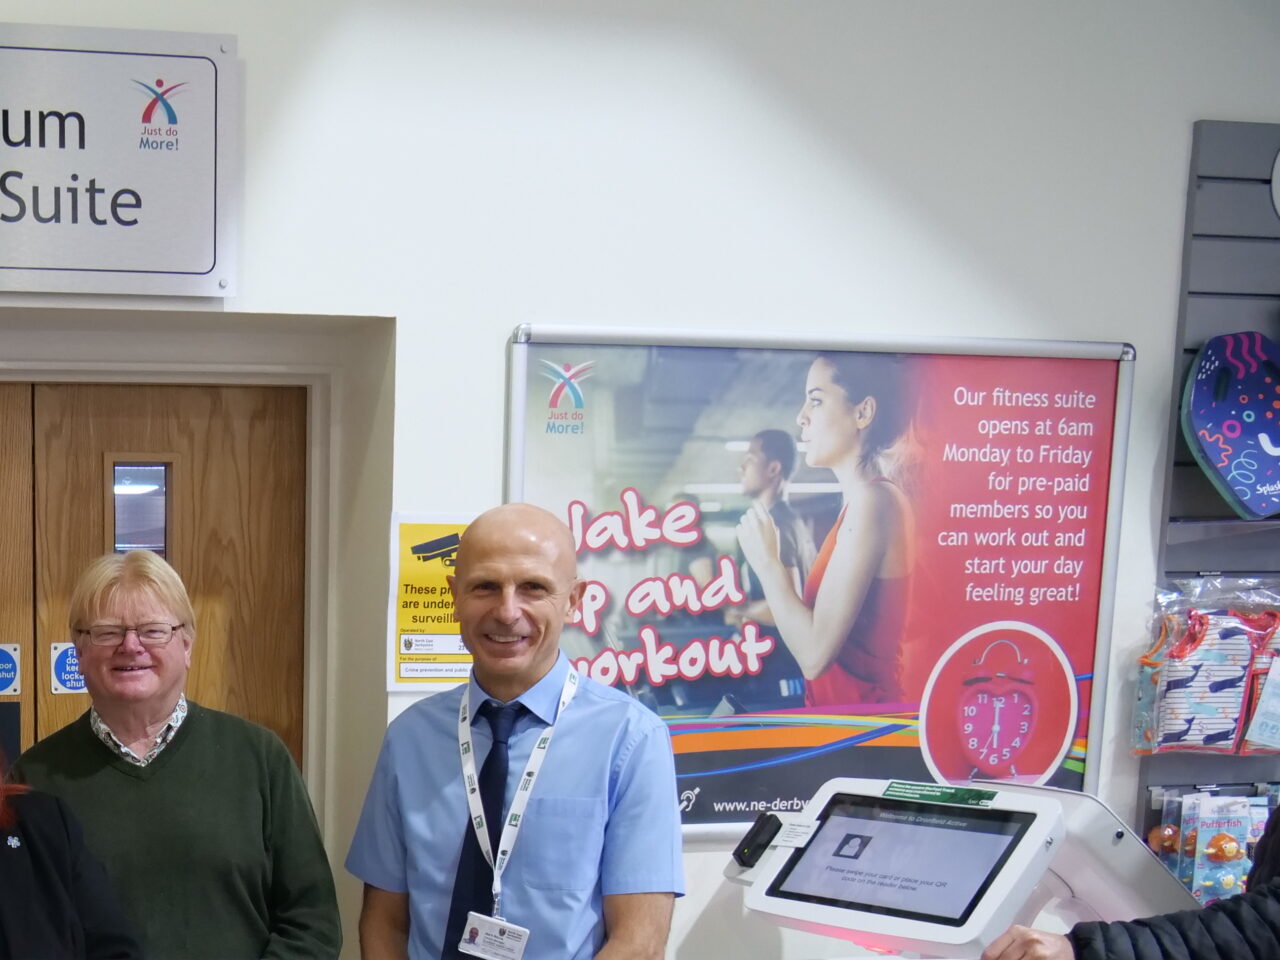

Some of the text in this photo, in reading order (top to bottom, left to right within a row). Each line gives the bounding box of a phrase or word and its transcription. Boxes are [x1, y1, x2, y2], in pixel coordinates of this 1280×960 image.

[141, 126, 178, 136] Just do
[139, 137, 179, 151] More!
[954, 387, 1096, 408] Our fitness suite
[548, 410, 584, 420] Just do
[545, 421, 584, 434] More!
[978, 418, 1094, 438] opens at 6am
[943, 443, 1093, 468] Monday to Friday
[988, 472, 1089, 495] for pre-paid
[950, 500, 1087, 523] members so you
[938, 528, 1085, 547] can work out and
[965, 556, 1084, 578] start your day
[404, 584, 437, 595] These
[627, 556, 744, 614] and
[965, 583, 1080, 605] feeling great!
[402, 599, 455, 609] are under
[977, 693, 987, 704] 11
[1013, 693, 1018, 704] 1
[963, 706, 976, 716] 10
[1023, 704, 1031, 715] 2
[964, 723, 973, 733] 9
[1020, 722, 1028, 733] 3
[969, 738, 977, 749] 8
[1012, 737, 1021, 748] 4
[979, 749, 988, 760] 7
[1002, 748, 1010, 759] 5
[989, 754, 998, 765] 6
[1200, 819, 1242, 829] Pufferfish
